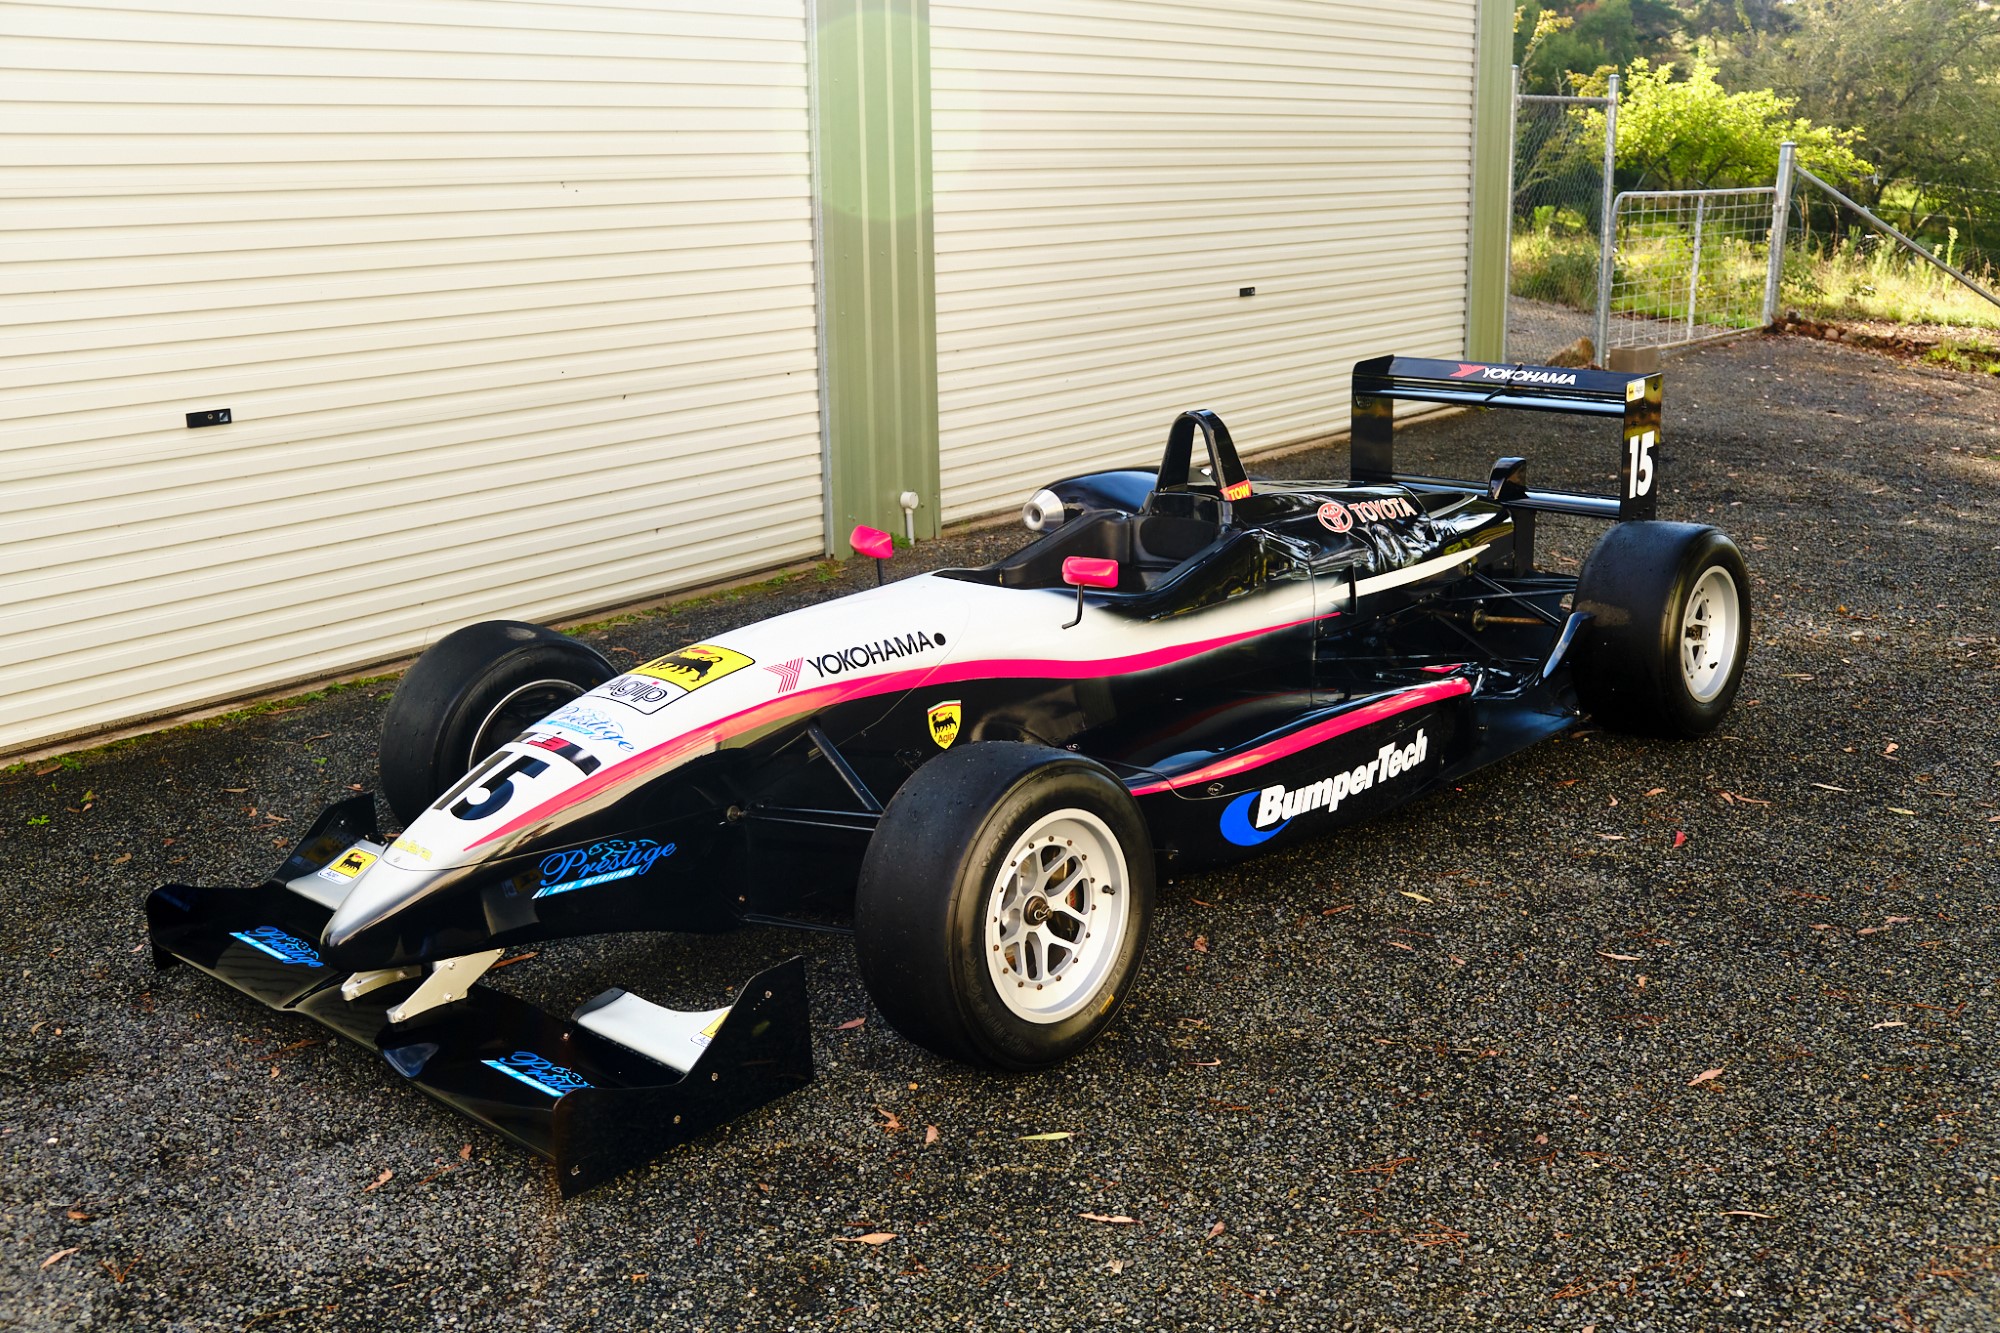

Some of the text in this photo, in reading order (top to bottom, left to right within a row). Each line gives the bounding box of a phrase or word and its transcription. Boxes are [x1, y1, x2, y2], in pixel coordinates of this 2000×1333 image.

[1482, 367, 1577, 386] YOKOHAMA
[1629, 431, 1655, 499] 15
[1228, 483, 1250, 500] TOW
[1348, 497, 1418, 524] TOYOTA
[806, 631, 935, 678] YOKOHAMA
[600, 676, 668, 702] Agip
[937, 732, 955, 744] Agip
[433, 750, 550, 820] 15
[1255, 728, 1428, 829] BumperTech
[539, 842, 677, 887] Prestige
[552, 881, 576, 893] CAR
